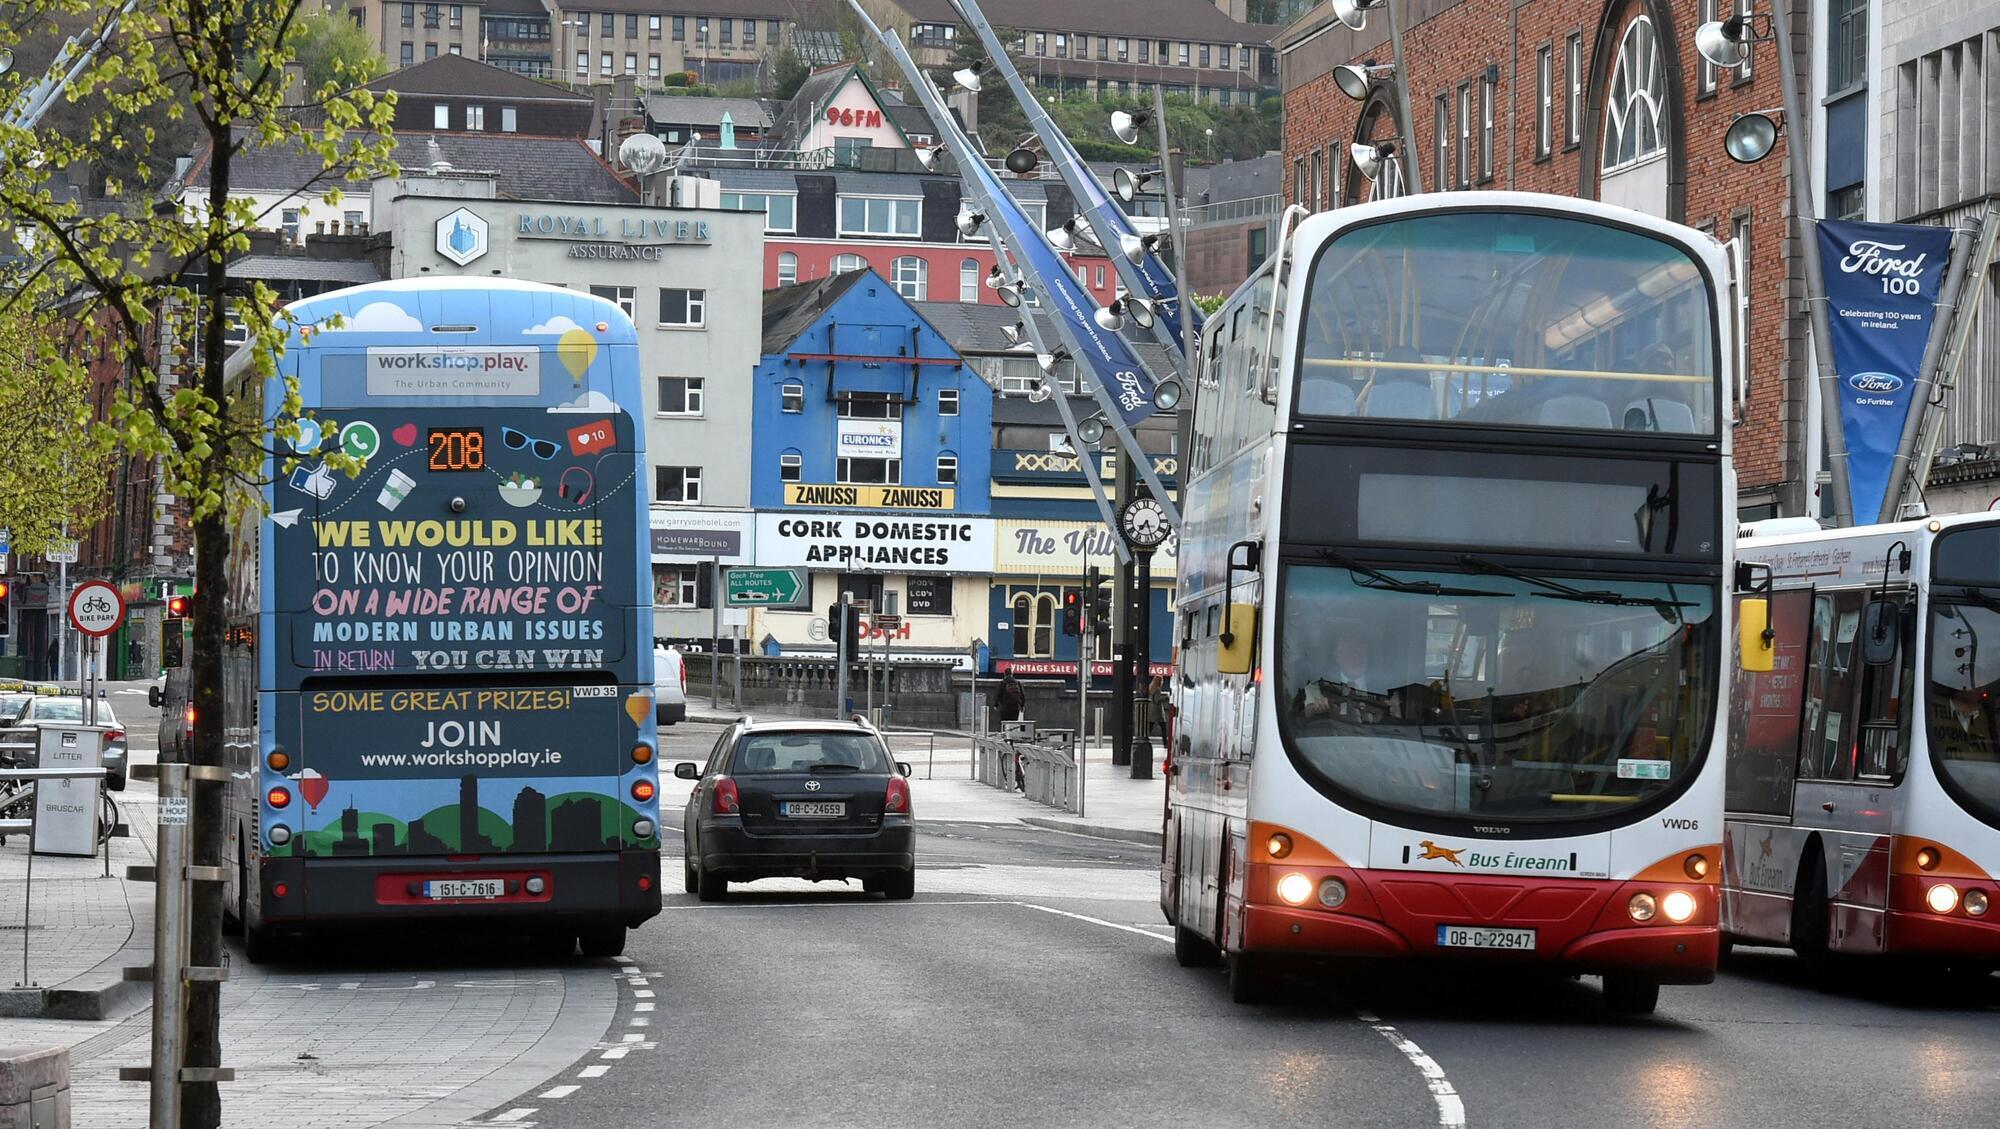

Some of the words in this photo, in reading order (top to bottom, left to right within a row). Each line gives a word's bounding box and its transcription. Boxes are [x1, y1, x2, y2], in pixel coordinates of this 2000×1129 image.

[519, 213, 609, 237] ROYAL
[623, 217, 712, 240] LIVER
[568, 243, 663, 261] ASSURANCE
[1839, 240, 1927, 278] Ford
[1881, 278, 1920, 295] 100
[1054, 278, 1077, 311] Celebrating
[1075, 308, 1085, 321] 100
[1082, 319, 1095, 336] years
[1839, 309, 1884, 320] Celebrating
[1885, 311, 1900, 320] 100
[1900, 313, 1921, 321] years
[1870, 321, 1898, 329] Ireland.
[378, 353, 528, 372] work.shop.play.
[394, 380, 413, 388] The
[417, 380, 448, 388] Urban
[452, 380, 511, 390] Community
[1115, 371, 1148, 408] Ford
[1858, 375, 1893, 390] Ford
[1118, 393, 1135, 412] 100
[1867, 398, 1894, 406] Further
[591, 429, 605, 441] 10
[843, 435, 891, 445] EURONICS
[429, 431, 484, 470] 208
[796, 486, 857, 505] ZANUSSI
[882, 489, 942, 507] ZANUSSI
[650, 518, 740, 528] ww.garryvoehotel.com
[778, 520, 843, 538] CORK
[855, 522, 972, 541] DOMESTIC
[312, 520, 371, 547] WE
[378, 520, 517, 547] WOULD
[527, 519, 602, 546] LIKE
[1015, 528, 1056, 554] The
[1064, 529, 1114, 556] Vill
[699, 540, 728, 548] BOUND
[806, 545, 949, 565] APPLIANCES
[312, 552, 339, 583] TO
[353, 551, 422, 584] KNOW
[437, 551, 494, 584] YOUR
[508, 550, 602, 583] OPINION
[312, 589, 360, 616] ON
[365, 589, 379, 616] A
[385, 588, 455, 618] WIDE
[460, 587, 550, 615] RANGE
[556, 586, 602, 615] OF
[79, 614, 95, 622] BIKE
[96, 613, 115, 622] PARK
[313, 621, 418, 643] MODERN
[430, 620, 513, 642] URBAN
[525, 620, 603, 640] ISSUES
[312, 650, 332, 672] IN
[338, 650, 394, 671] RETURN
[411, 650, 468, 670] YOU
[475, 650, 535, 670] CAN
[543, 649, 602, 669] WIN
[1011, 664, 1048, 673] VINTAGE
[1050, 665, 1071, 673] SALE
[1098, 665, 1112, 673] ON
[575, 688, 602, 696] VWD
[604, 687, 616, 696] 35
[313, 692, 384, 713] SOME
[390, 691, 472, 711] GREAT
[478, 690, 571, 710] PRIZES!
[421, 721, 501, 748] JOIN
[361, 749, 562, 767] www.workshopplay.ie
[46, 804, 84, 813] BRUSCAR
[789, 804, 841, 814] 08-C-24659
[1473, 826, 1510, 834] VOLVO
[1661, 818, 1699, 831] VWD6
[1469, 853, 1500, 868] Bus
[1504, 852, 1568, 870] Éireann
[439, 882, 496, 896] 151-C-7616
[1450, 930, 1531, 948] 08-C-22947
